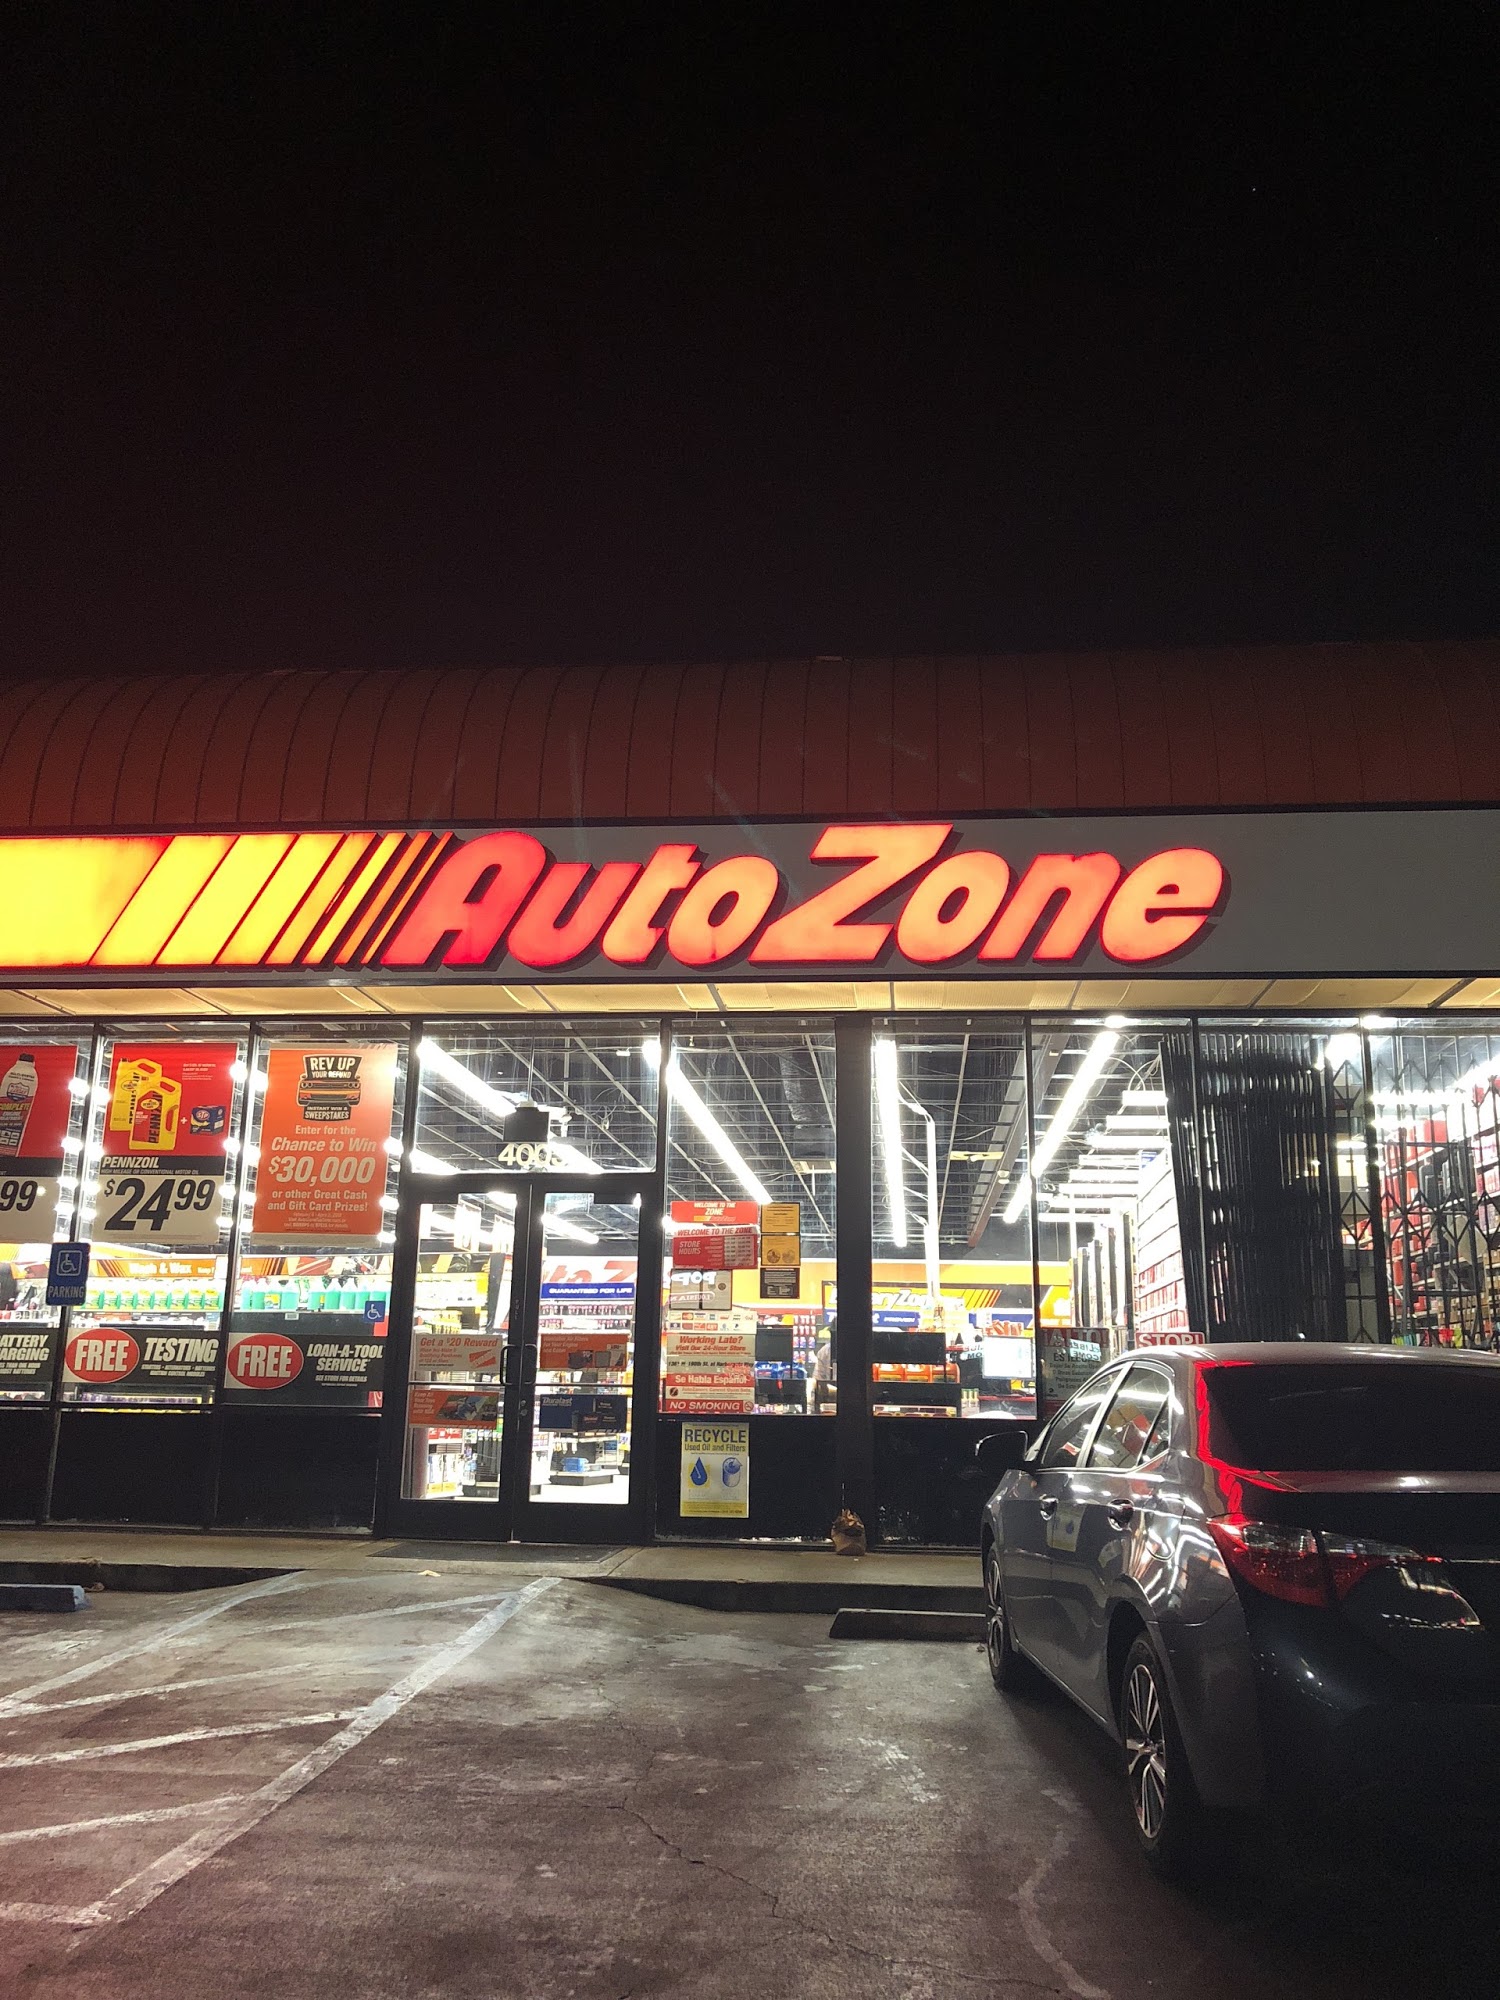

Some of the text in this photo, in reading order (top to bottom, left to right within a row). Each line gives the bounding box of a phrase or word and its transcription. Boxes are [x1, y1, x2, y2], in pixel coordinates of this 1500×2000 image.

[383, 823, 1223, 966] AutoZone
[310, 1057, 356, 1070] REV UP
[328, 1071, 352, 1079] REFUND
[149, 1090, 163, 1143] PENNZI
[305, 1111, 349, 1120] SWEEPSTAKES
[295, 1125, 356, 1135] Enter for the
[271, 1137, 377, 1152] Chance to Win
[102, 1156, 159, 1169] PENNZOIL
[268, 1156, 376, 1187] $30,000
[0, 1180, 38, 1212] 99
[285, 1190, 311, 1199] other
[314, 1190, 341, 1199] Great
[343, 1190, 368, 1200] Cash
[268, 1201, 368, 1212] and Gift Card Prizes!
[677, 1228, 710, 1236] WELCOME
[159, 1262, 168, 1274] &
[169, 1262, 192, 1274] Wax
[48, 1286, 85, 1298] PARKING
[0, 1335, 49, 1347] ATTERY
[420, 1338, 435, 1347] Get
[464, 1338, 498, 1347] Reward
[680, 1336, 743, 1344] Working Late?
[1139, 1334, 1200, 1345] STOP!
[0, 1348, 50, 1360] ARGING
[74, 1339, 129, 1371] FREE
[144, 1338, 219, 1363] TESTING
[306, 1343, 383, 1358] LOAN-A-TOOL
[237, 1345, 293, 1378] FREE
[316, 1358, 369, 1372] SERVICE
[675, 1375, 686, 1383] Se
[688, 1375, 712, 1383] Habla
[670, 1401, 740, 1410] NO SMOKING
[684, 1428, 746, 1443] RECYCLE
[726, 1444, 746, 1452] Filters
